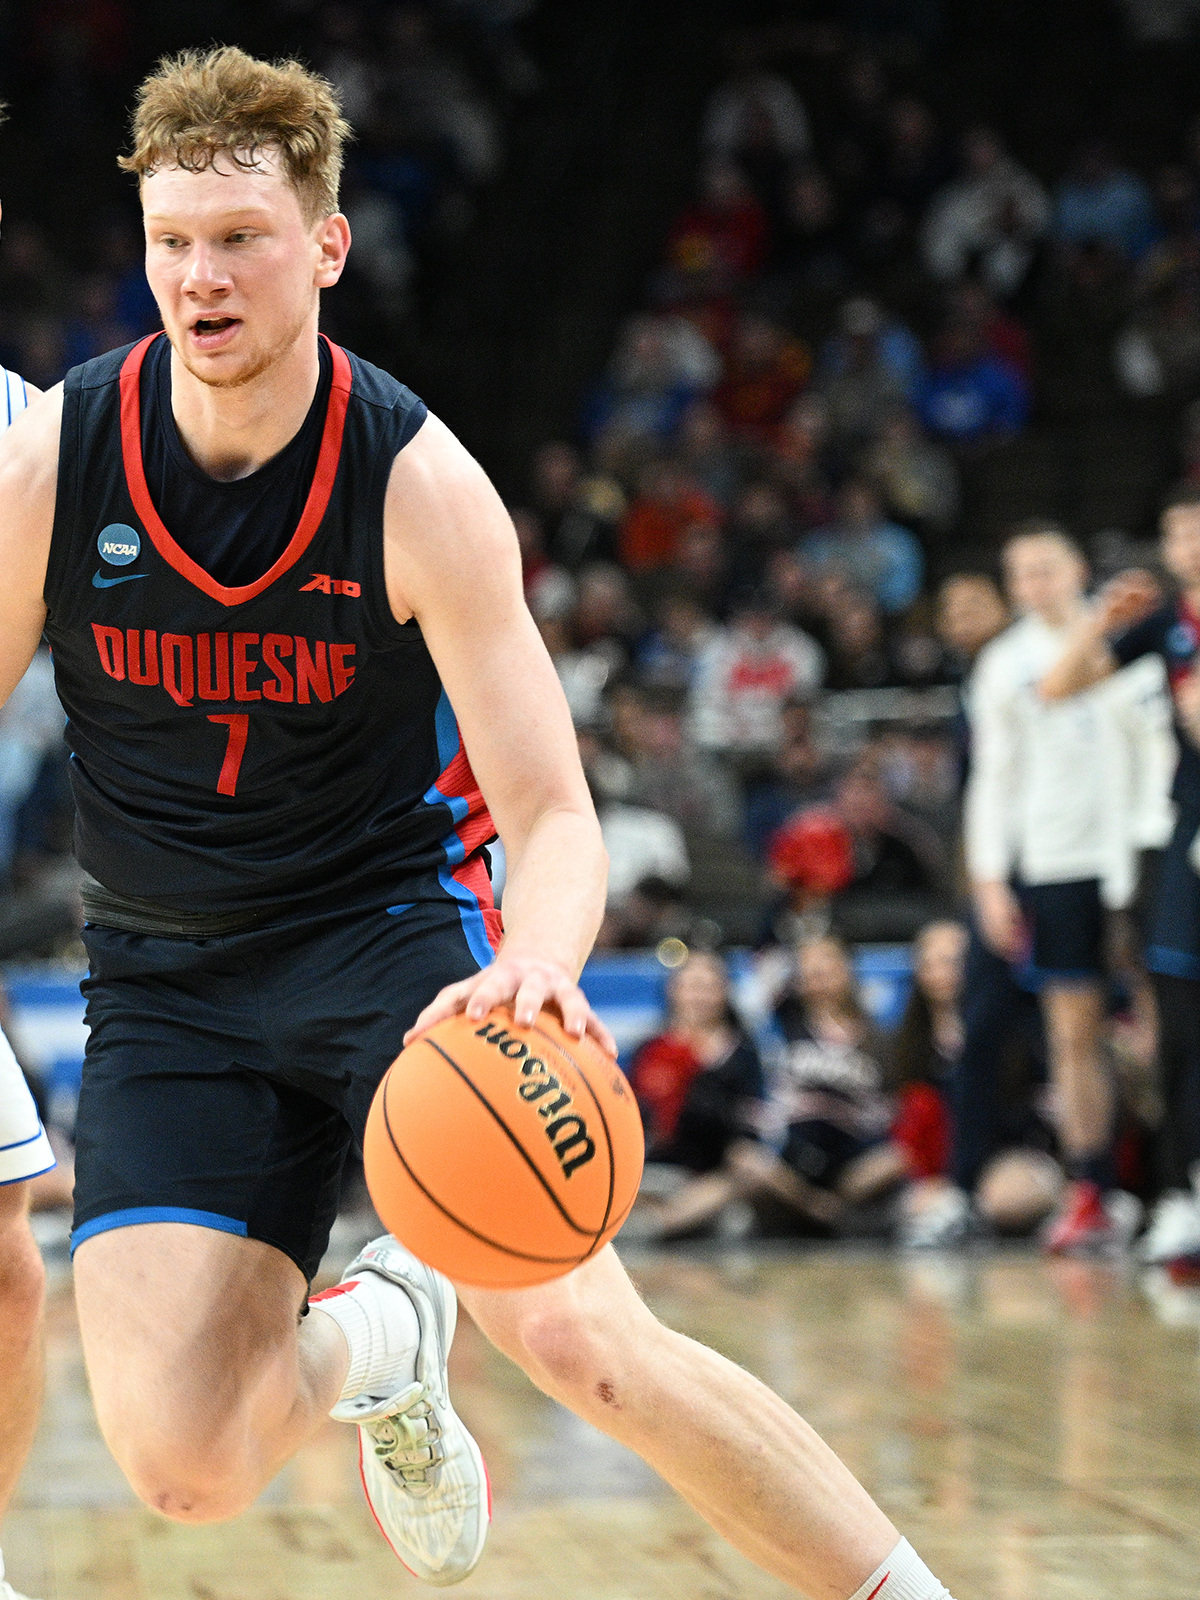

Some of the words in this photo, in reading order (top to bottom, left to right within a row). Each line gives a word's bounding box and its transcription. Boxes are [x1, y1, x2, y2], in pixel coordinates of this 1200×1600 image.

[103, 542, 138, 557] NCAA
[298, 573, 362, 598] A10
[91, 622, 356, 707] DUQUESNE
[206, 713, 249, 796] 7
[474, 1022, 596, 1182] Wilson
